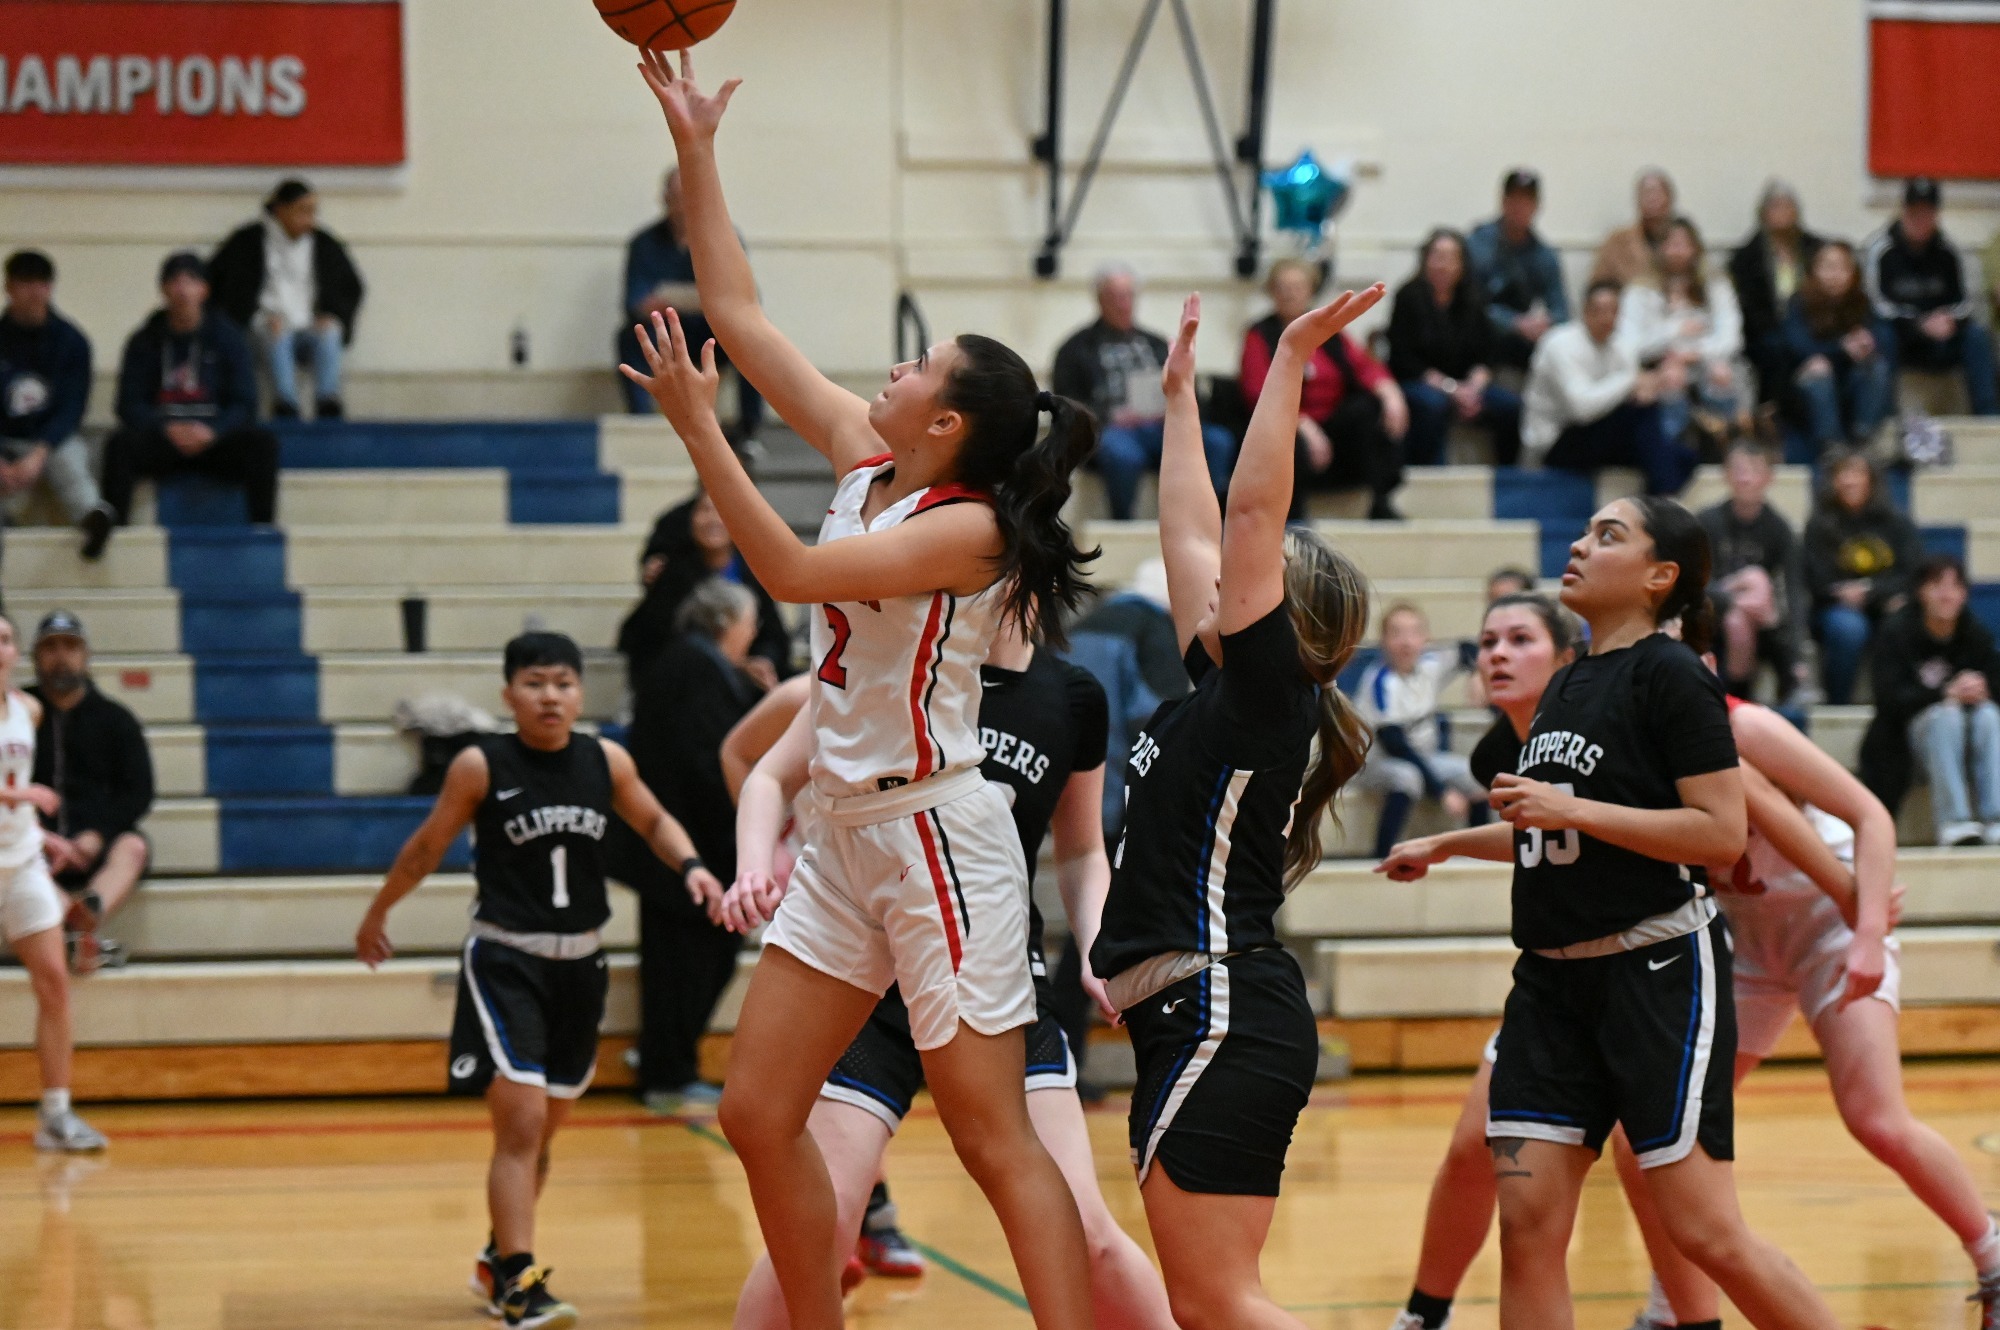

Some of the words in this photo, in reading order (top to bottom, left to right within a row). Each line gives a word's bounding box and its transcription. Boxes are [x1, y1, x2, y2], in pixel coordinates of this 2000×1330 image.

[0, 54, 307, 117] AMPIONS
[818, 602, 851, 690] 2
[977, 726, 1050, 784] PERS
[504, 805, 608, 846] CLIPPERS
[550, 845, 570, 908] 1
